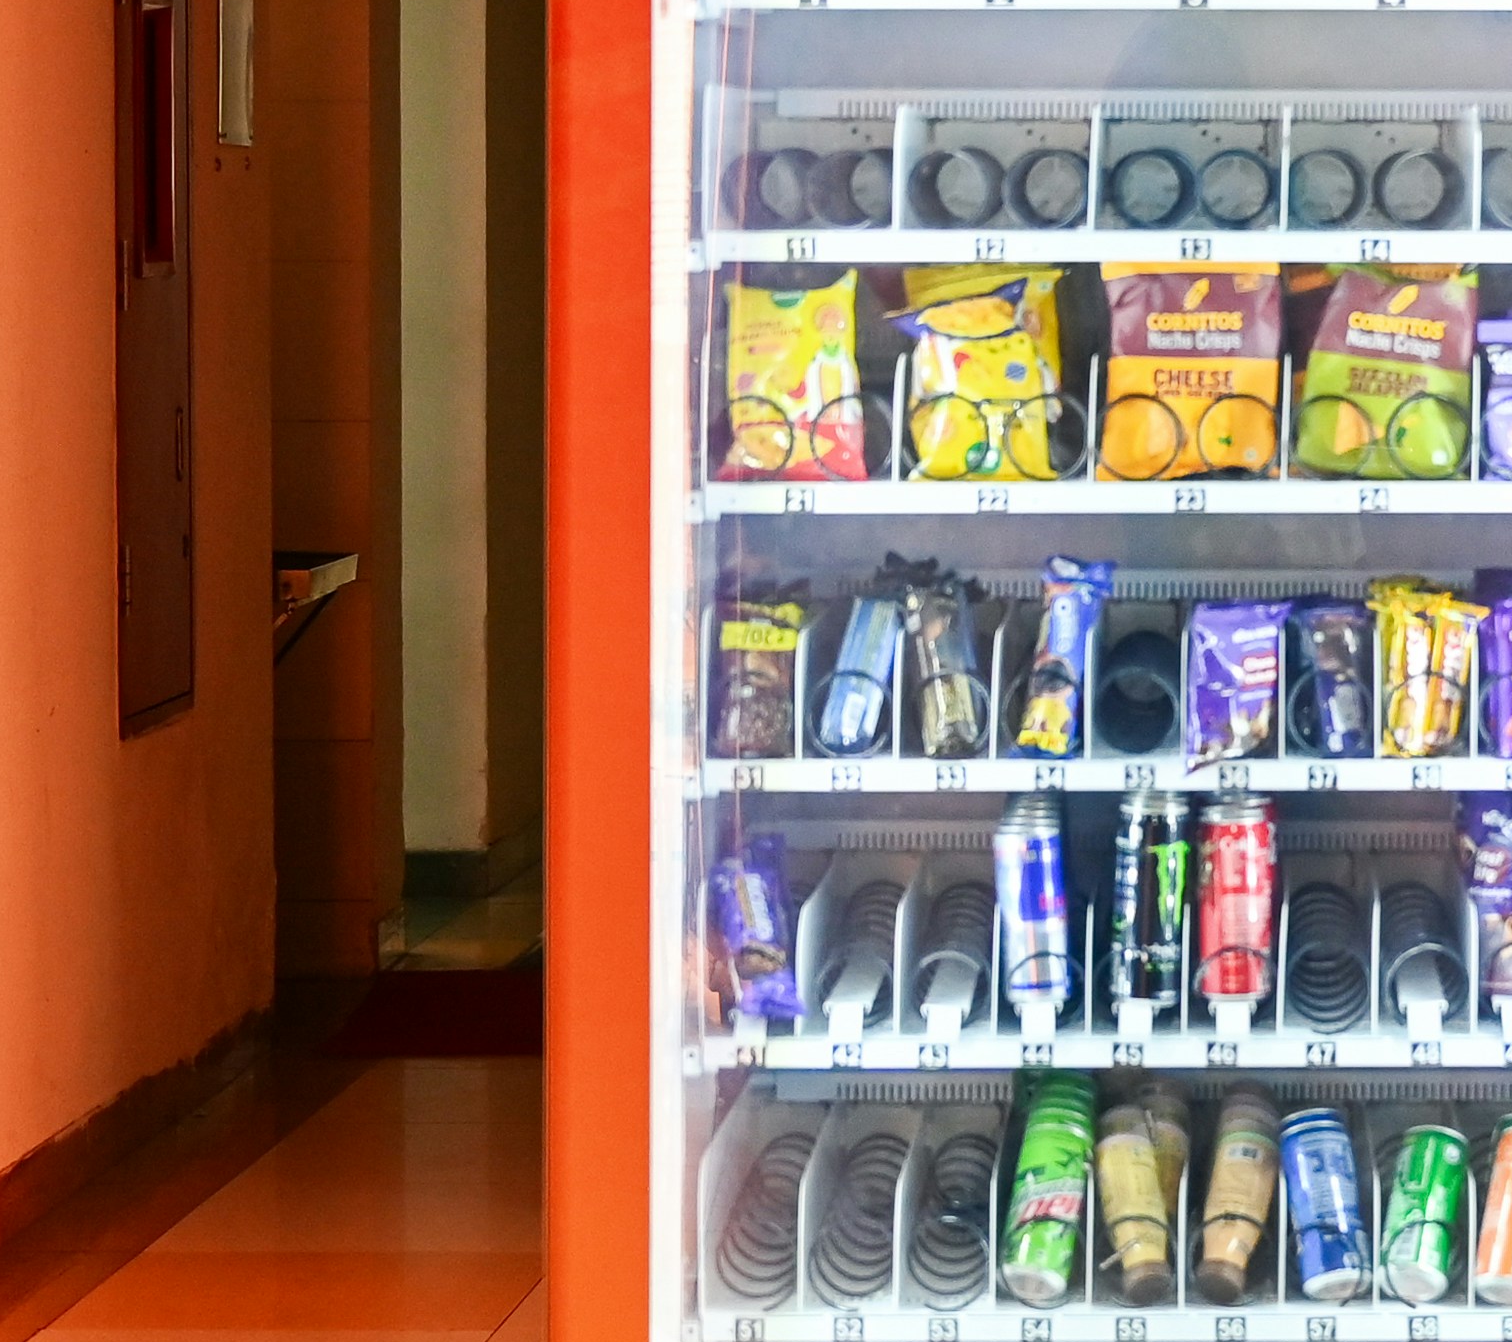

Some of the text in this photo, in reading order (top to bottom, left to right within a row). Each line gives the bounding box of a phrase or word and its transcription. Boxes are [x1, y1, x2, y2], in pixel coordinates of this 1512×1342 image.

[788, 238, 814, 259] 11
[977, 238, 1004, 259] 12
[1182, 238, 1210, 259] 13
[1362, 239, 1390, 260] 14
[1153, 368, 1234, 389] CHEESE
[786, 488, 814, 511] 21
[978, 488, 1008, 511] 22
[1176, 488, 1205, 510] 23
[1360, 488, 1388, 510] 24
[735, 766, 763, 790] 31
[832, 766, 861, 790] 32
[937, 766, 965, 790] 33
[1036, 766, 1064, 789] 34
[1219, 765, 1249, 789] 36
[1308, 765, 1337, 789] 37
[832, 1044, 861, 1066] 42
[1022, 1044, 1052, 1065] 44
[1113, 1044, 1143, 1066] 45
[1207, 1043, 1237, 1065] 46
[1306, 1043, 1336, 1066] 47
[735, 1319, 763, 1341] 51
[834, 1318, 862, 1341] 52
[929, 1319, 957, 1341] 53
[1023, 1318, 1050, 1341] 54
[1117, 1317, 1145, 1341] 55
[1217, 1317, 1245, 1341] 56
[1308, 1317, 1336, 1341] 57
[1410, 1316, 1437, 1340] 58
